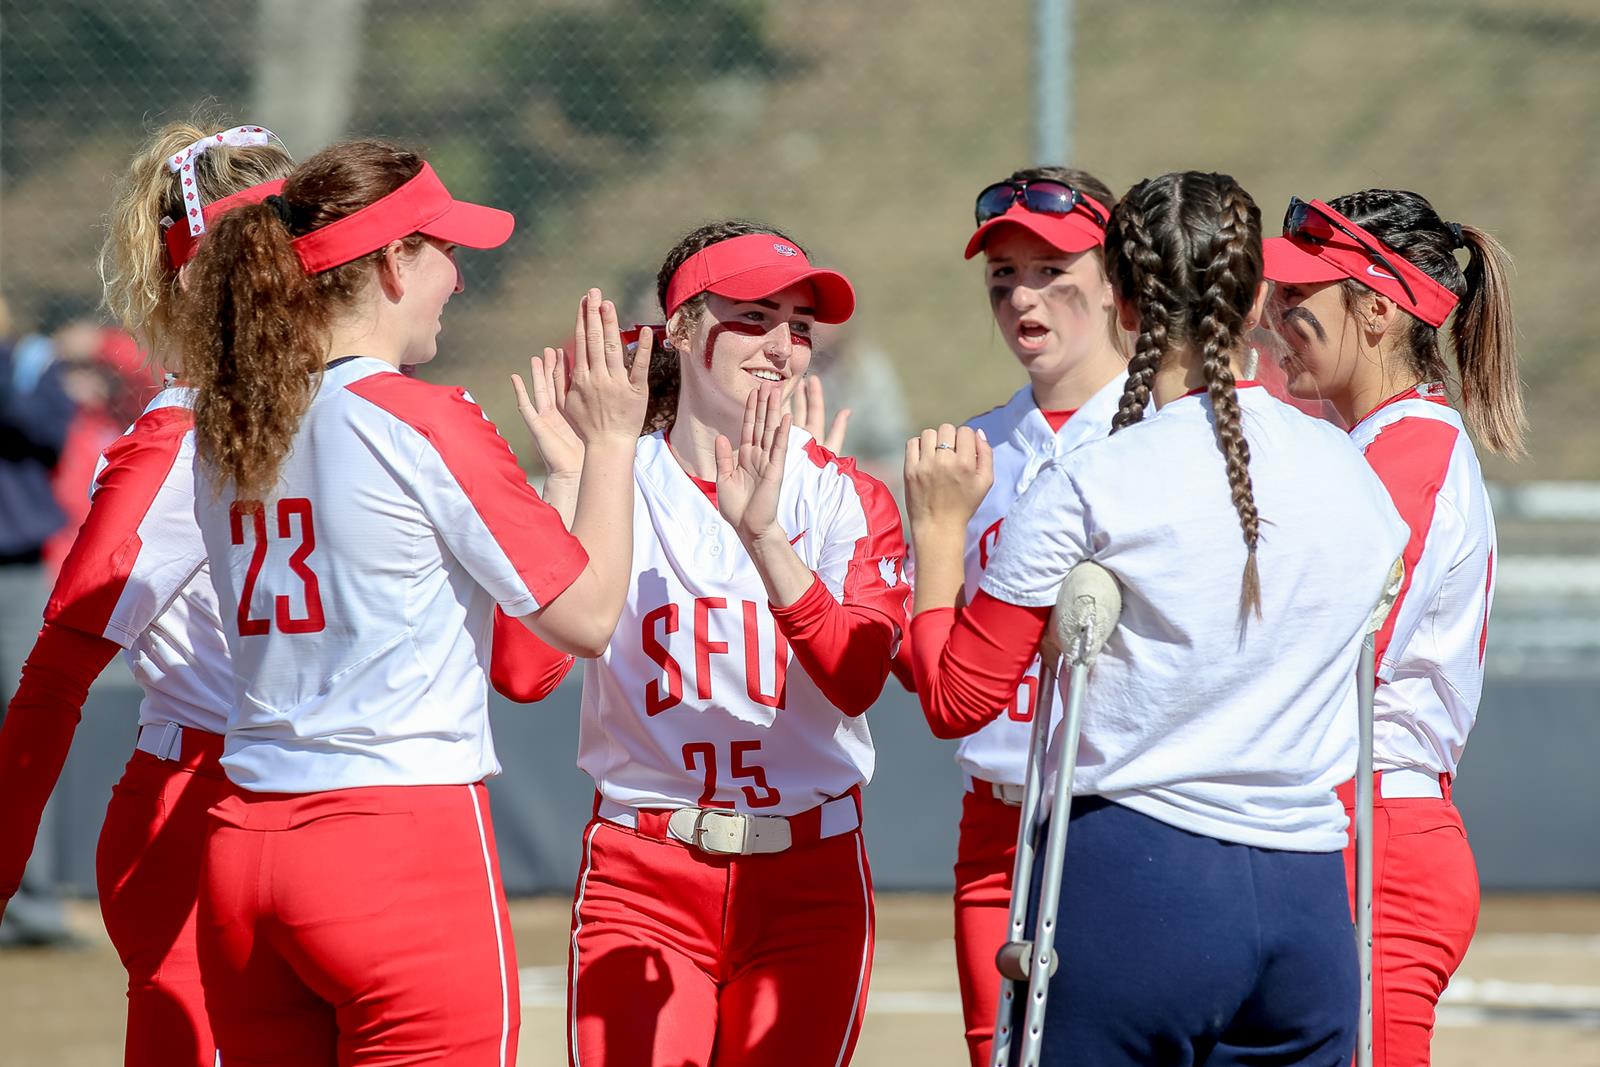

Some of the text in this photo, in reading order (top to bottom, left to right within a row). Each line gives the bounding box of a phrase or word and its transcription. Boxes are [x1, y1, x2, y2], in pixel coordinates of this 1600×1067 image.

[230, 498, 325, 636] 23
[642, 597, 788, 717] SFU
[682, 740, 781, 809] 25
